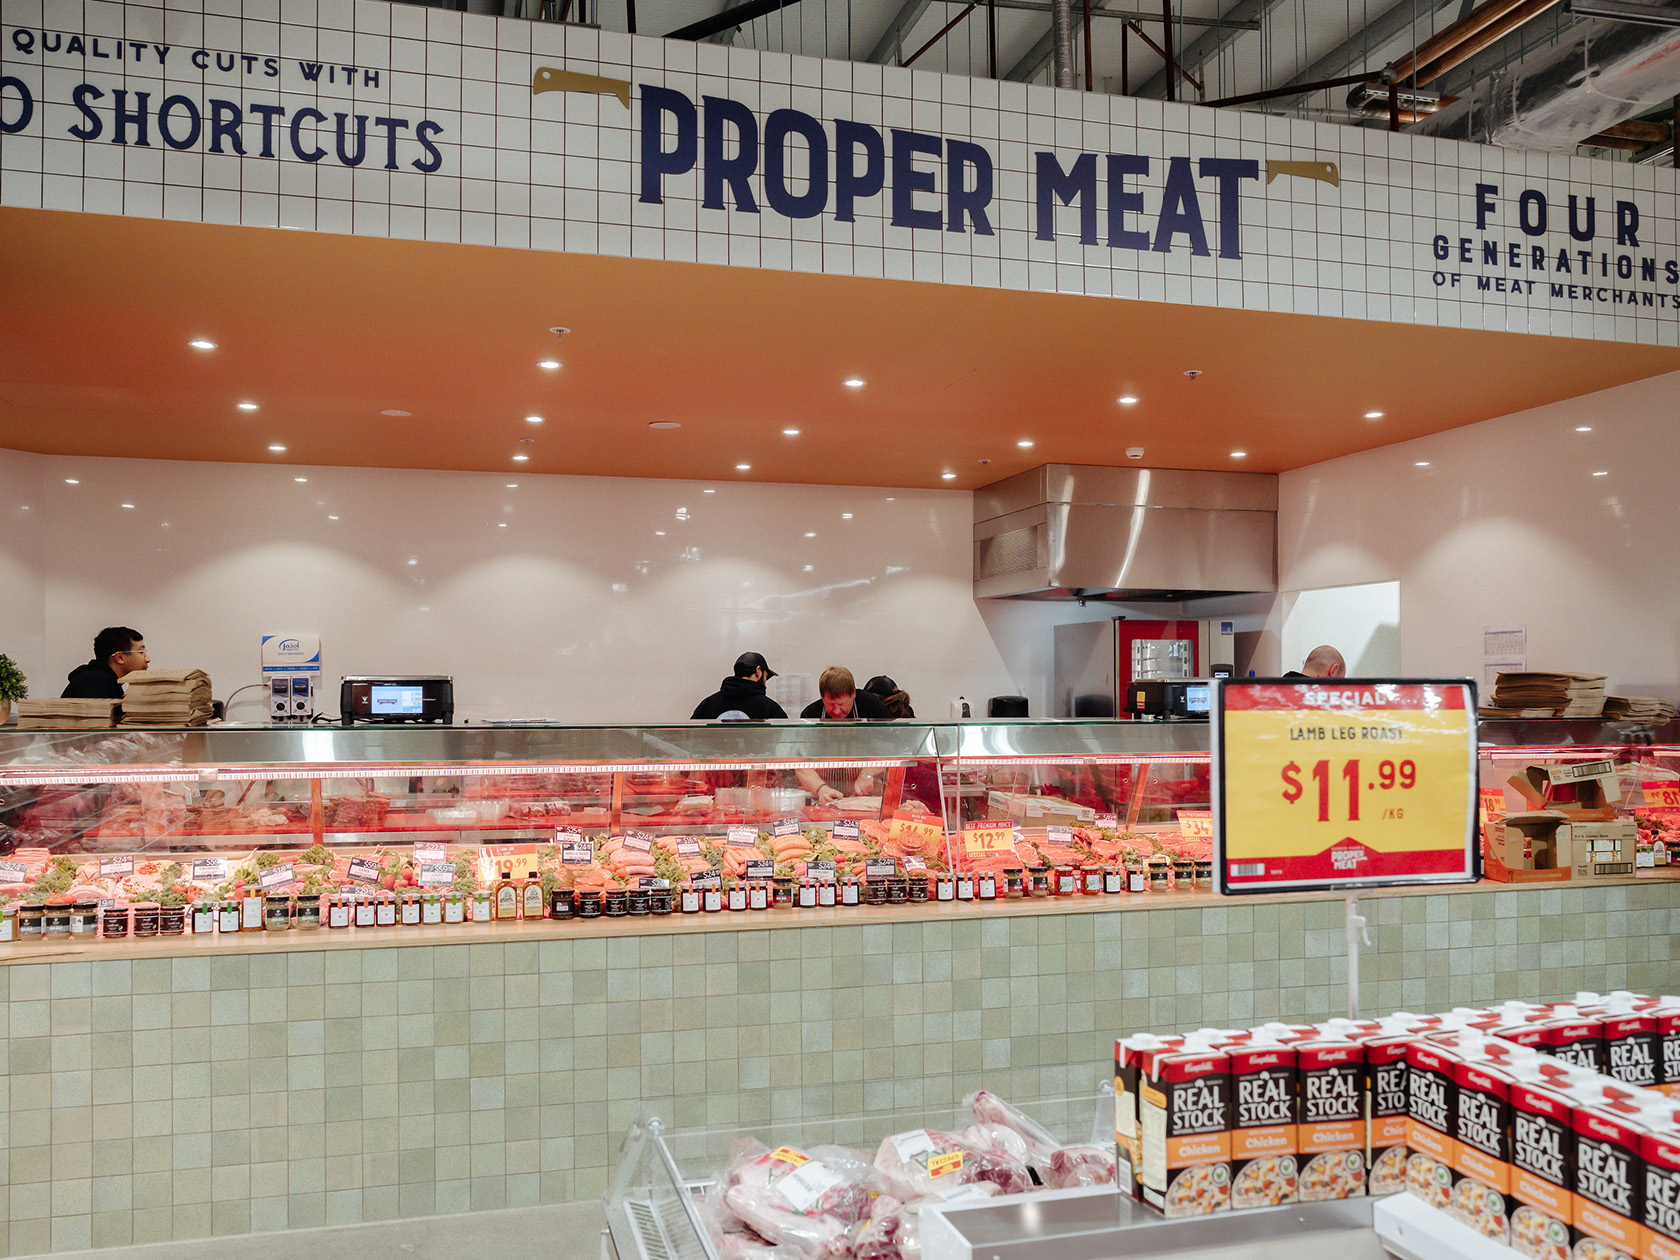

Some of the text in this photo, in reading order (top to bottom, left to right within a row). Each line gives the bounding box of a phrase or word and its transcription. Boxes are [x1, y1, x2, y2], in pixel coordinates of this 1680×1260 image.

[12, 28, 381, 89] QUALITY CUTS WITH
[68, 84, 445, 174] SHORTCUTS
[638, 84, 1260, 260] PROPER MEAT
[1475, 183, 1640, 247] FOUR
[1433, 234, 1680, 284] GENERATIONS
[1432, 271, 1680, 309] OF MEAT MERCHANTS
[1303, 691, 1386, 706] SPECIAL
[1290, 726, 1404, 741] LAMB LEG ROAST
[1281, 759, 1416, 822] $11.99
[1382, 808, 1404, 820] /KG
[973, 832, 1005, 849] $12.99
[1610, 1043, 1654, 1067] REAL
[1611, 1064, 1655, 1081] STOCK
[1174, 1086, 1225, 1112] REAL
[1239, 1078, 1291, 1103] REAL
[1307, 1075, 1359, 1099] REAL
[1410, 1073, 1448, 1109] REAL
[1173, 1108, 1225, 1130] STOCK
[1239, 1101, 1292, 1121] STOCK
[1307, 1096, 1359, 1116] STOCK
[1409, 1096, 1448, 1127] STOCK
[1459, 1093, 1501, 1133] REAL
[1246, 1136, 1287, 1148] Chicken
[1312, 1131, 1354, 1143] Chicken
[1412, 1130, 1443, 1152] Chicken
[1458, 1117, 1502, 1152] STOCK
[1516, 1117, 1564, 1159] REAL
[931, 1154, 959, 1166] SPECIAL
[1179, 1144, 1220, 1157] Chicken
[1515, 1142, 1564, 1179] STOCK
[1461, 1154, 1495, 1178] Chicken
[1578, 1143, 1632, 1189] REAL
[1520, 1180, 1558, 1208] Chicken
[1577, 1169, 1632, 1210] STOCK
[1582, 1210, 1625, 1240] Chicken
